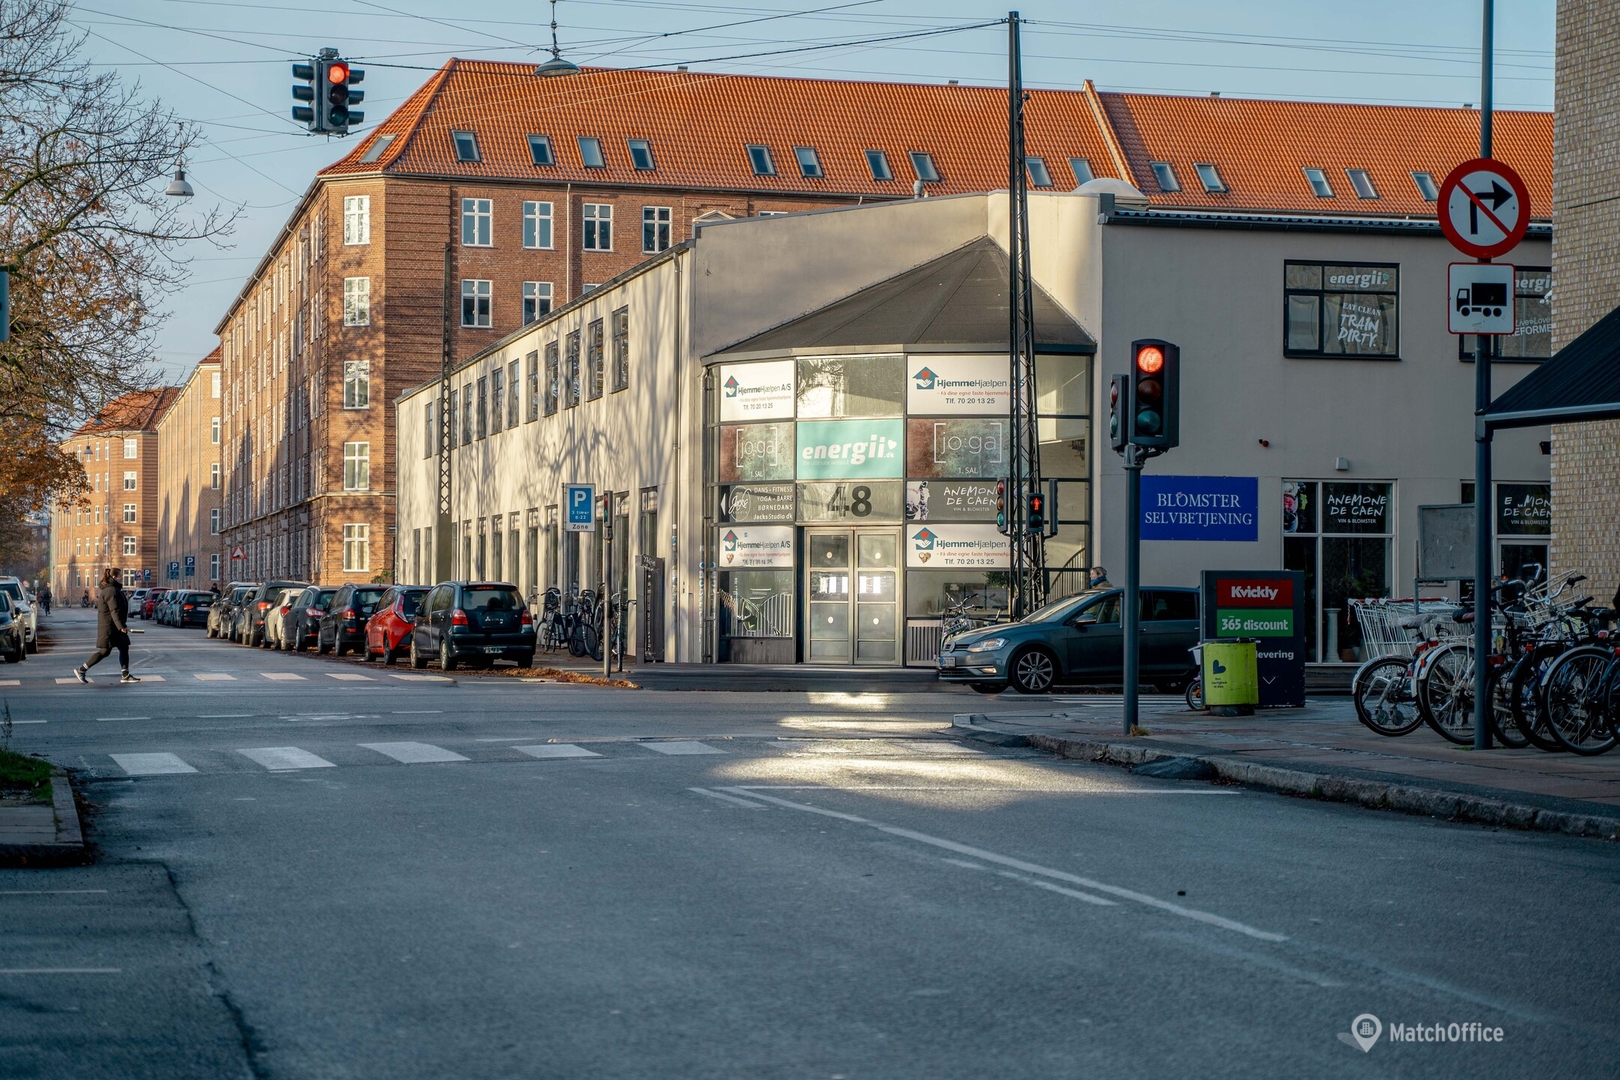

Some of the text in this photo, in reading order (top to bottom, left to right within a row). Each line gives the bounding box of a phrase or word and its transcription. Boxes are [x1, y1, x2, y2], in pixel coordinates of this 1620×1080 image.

[1343, 302, 1381, 316] EAT CLEAN
[1341, 314, 1379, 333] TRAIN
[1338, 327, 1377, 347] DIRTY.
[738, 385, 780, 396] HjemmeHjælpen
[937, 380, 1007, 389] HjemmeHjælpen
[944, 486, 997, 497] ANEMON
[575, 491, 586, 507] P
[827, 486, 872, 517] 48
[946, 497, 962, 505] DE
[1157, 493, 1241, 508] BLOMSTER
[1327, 494, 1386, 506] ANEMONE
[1330, 506, 1383, 516] DE CAEN
[1504, 508, 1520, 516] DE
[1145, 512, 1252, 527] SELVBETJENING
[737, 541, 780, 550] HjemmeHjælpen
[936, 540, 1006, 550] HjemmeHjælpen
[1231, 586, 1278, 600] Kvickly
[1222, 618, 1288, 630] 365 discount
